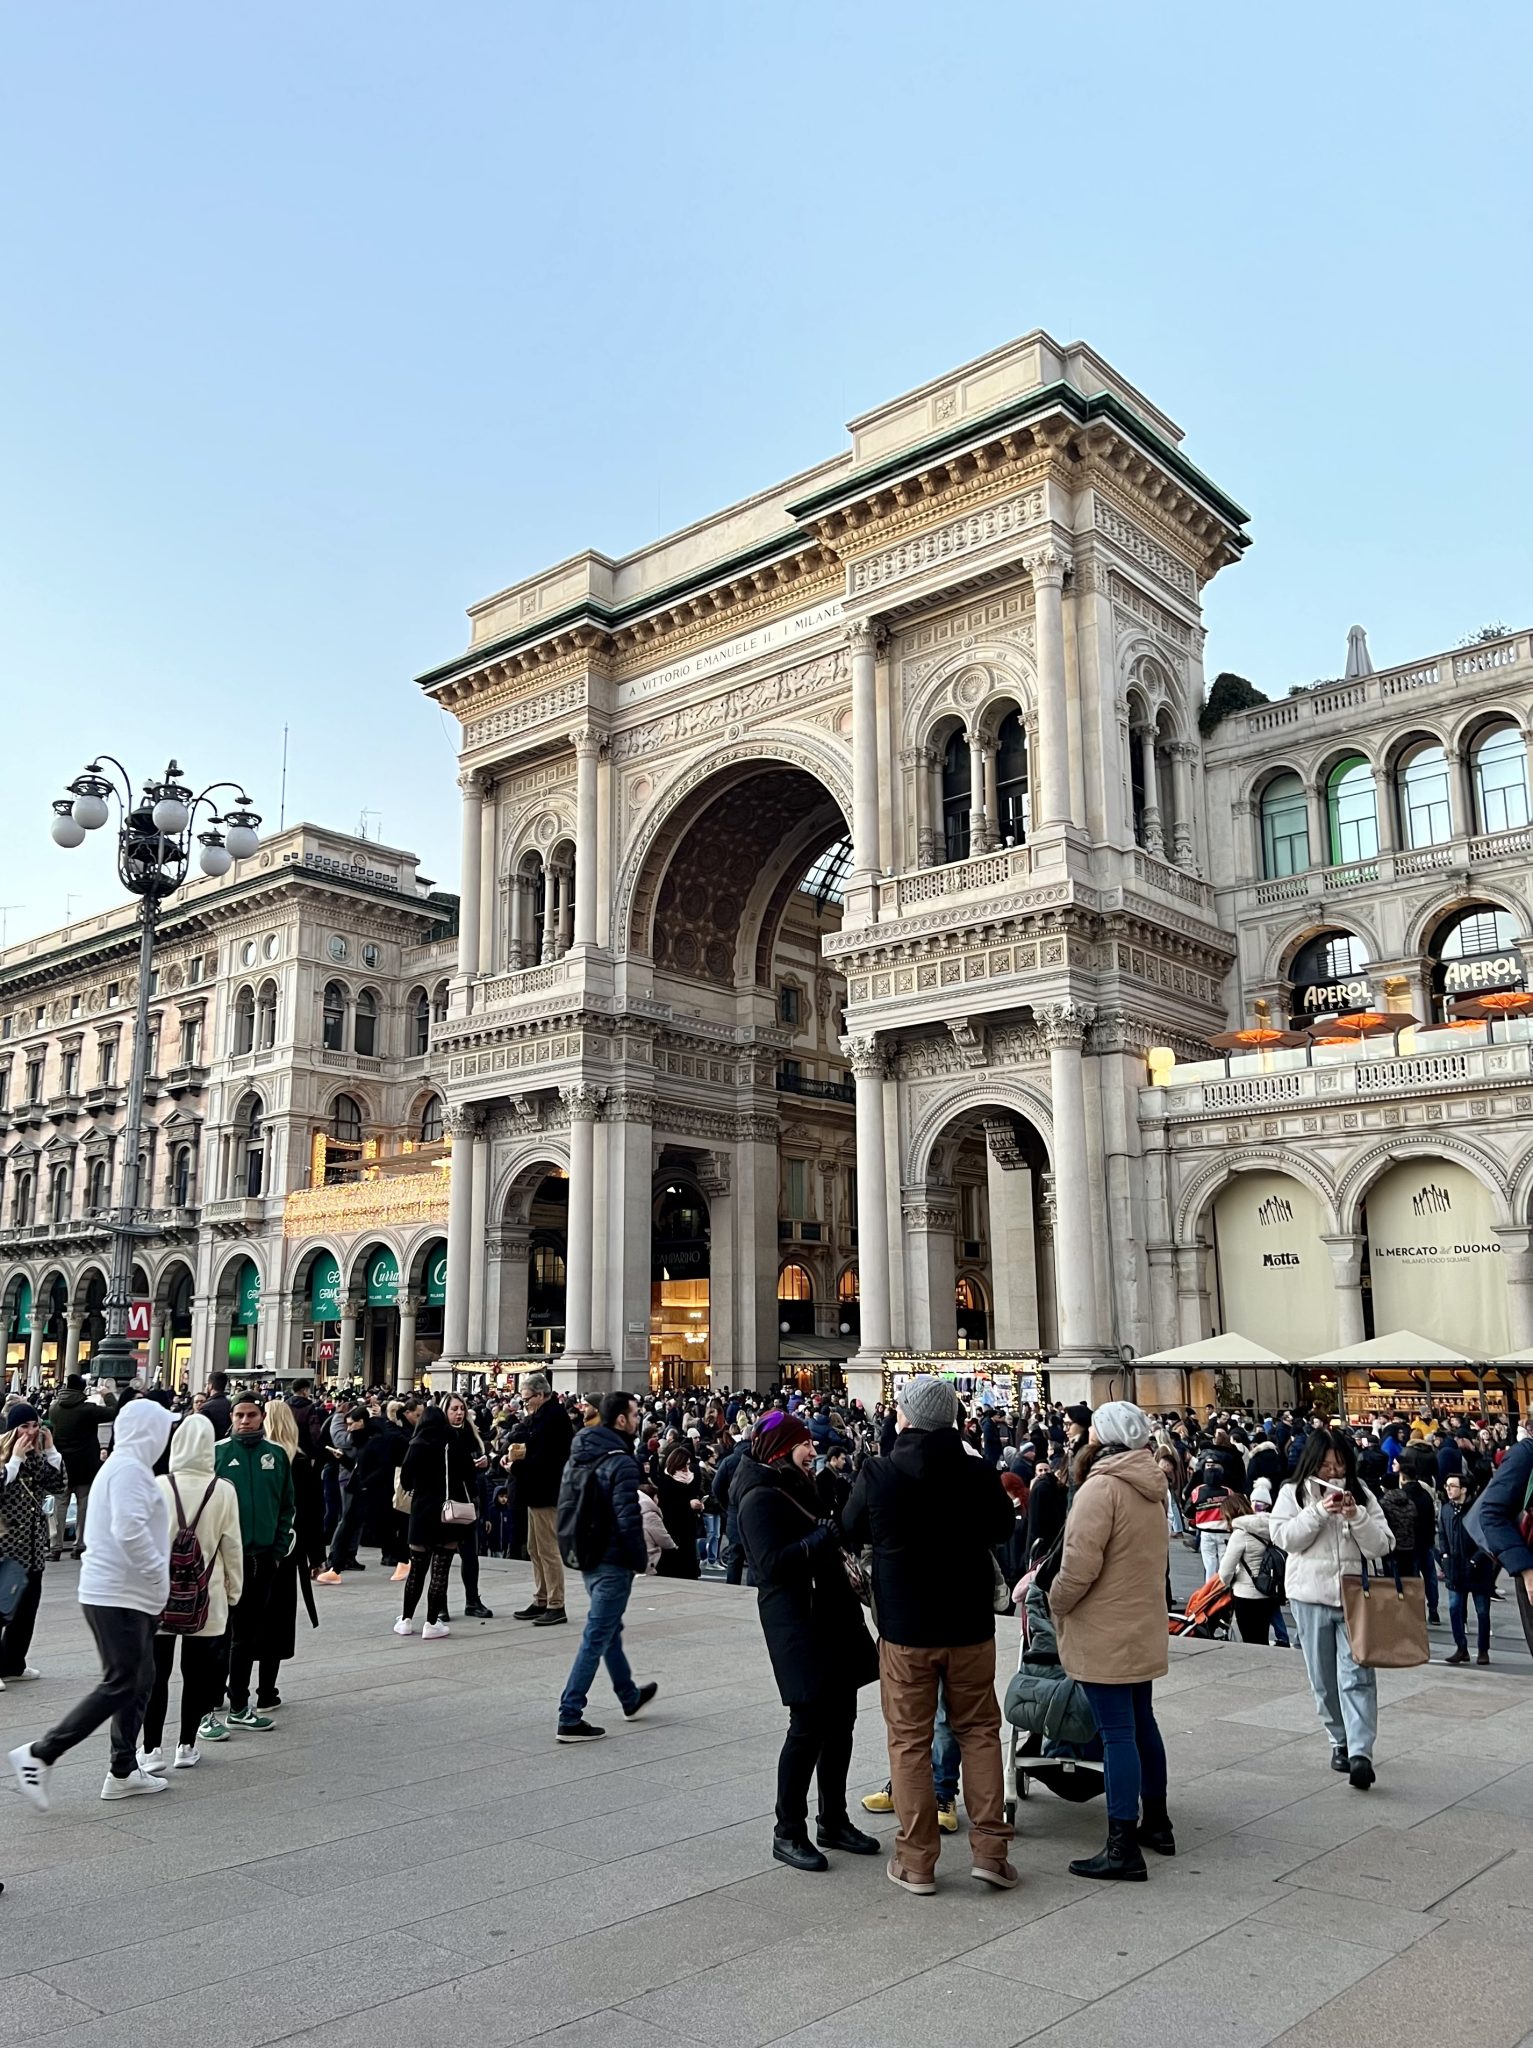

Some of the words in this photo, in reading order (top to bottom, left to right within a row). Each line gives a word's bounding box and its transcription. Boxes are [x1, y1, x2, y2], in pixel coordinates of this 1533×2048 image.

[629, 687, 636, 697] A
[642, 665, 690, 691] VITTORIO
[696, 640, 758, 670] EMANUELE
[1444, 957, 1521, 985] APEROL
[1445, 975, 1521, 992] TERRAZZA
[1304, 981, 1372, 1007] APEROL
[1304, 998, 1373, 1013] TERRAZZA
[1375, 1248, 1385, 1257] IL
[1386, 1246, 1437, 1257] MERCATO
[1454, 1244, 1501, 1254] DUOMO
[1263, 1253, 1300, 1267] Motta
[1402, 1257, 1426, 1265] MILANO
[320, 1345, 332, 1356] M
